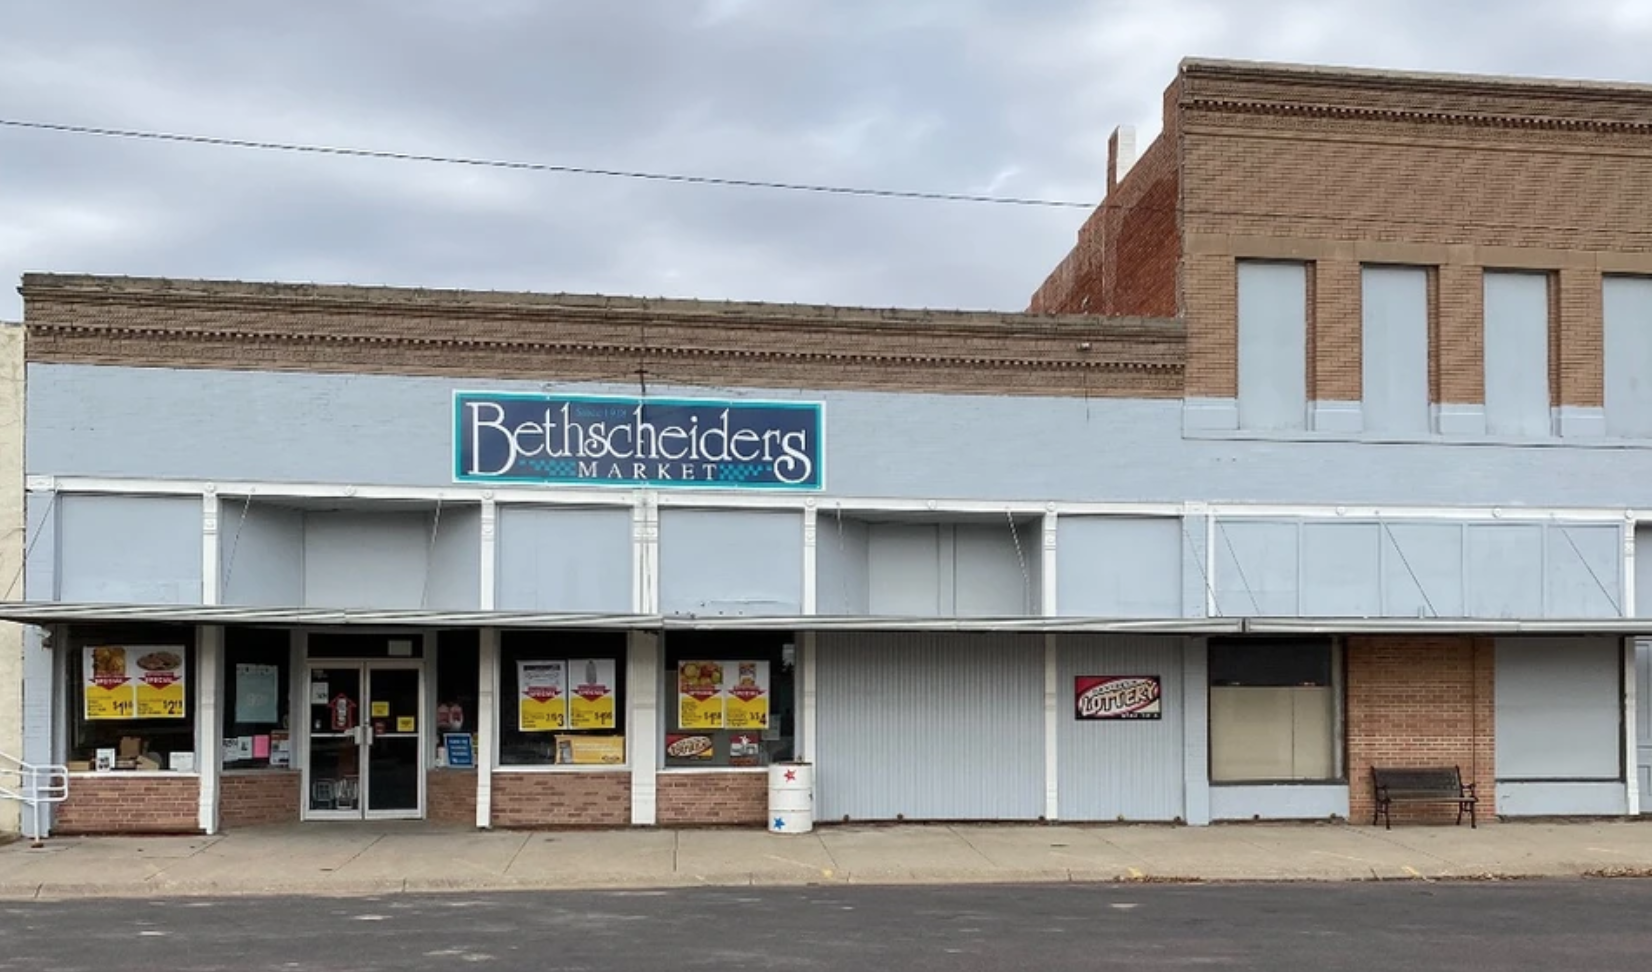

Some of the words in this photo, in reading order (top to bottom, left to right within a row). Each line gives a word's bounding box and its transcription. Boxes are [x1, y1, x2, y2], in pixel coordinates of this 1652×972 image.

[465, 402, 812, 484] Bethscheiders
[577, 461, 719, 480] MARKET
[1081, 680, 1157, 716] LOTTERY
